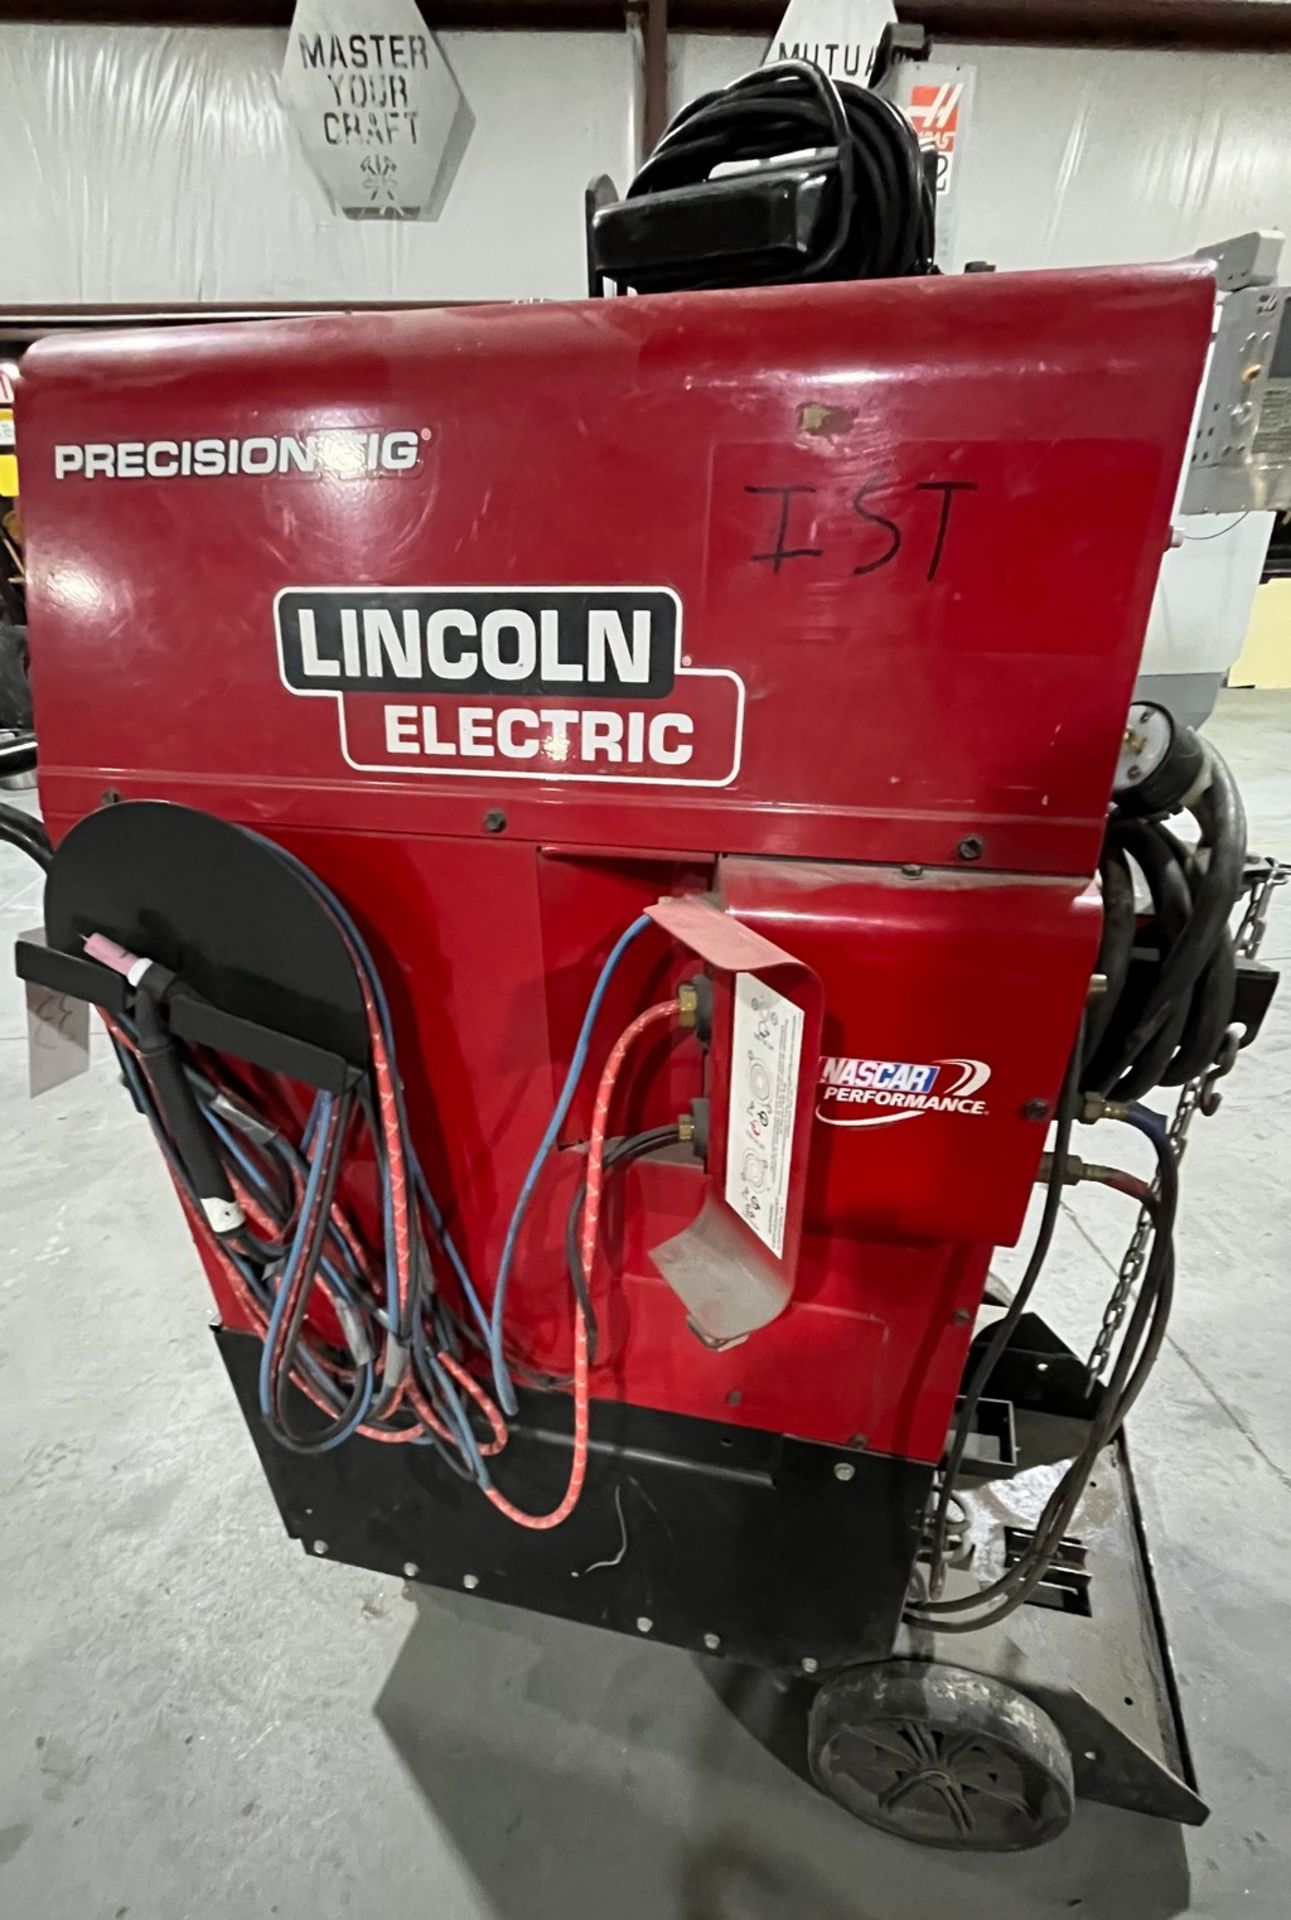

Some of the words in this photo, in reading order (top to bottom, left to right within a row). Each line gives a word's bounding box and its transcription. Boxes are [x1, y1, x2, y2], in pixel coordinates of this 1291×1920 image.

[299, 34, 429, 69] MASTER
[326, 74, 408, 107] YOUR
[323, 112, 418, 145] CRAFT
[54, 436, 316, 479] PRECISION
[743, 471, 979, 582] IST
[297, 608, 651, 683] LINCOLN
[384, 704, 694, 765] ELECTRIC
[822, 1057, 932, 1092] NASCAR
[823, 1086, 986, 1116] PERFORMANCE
